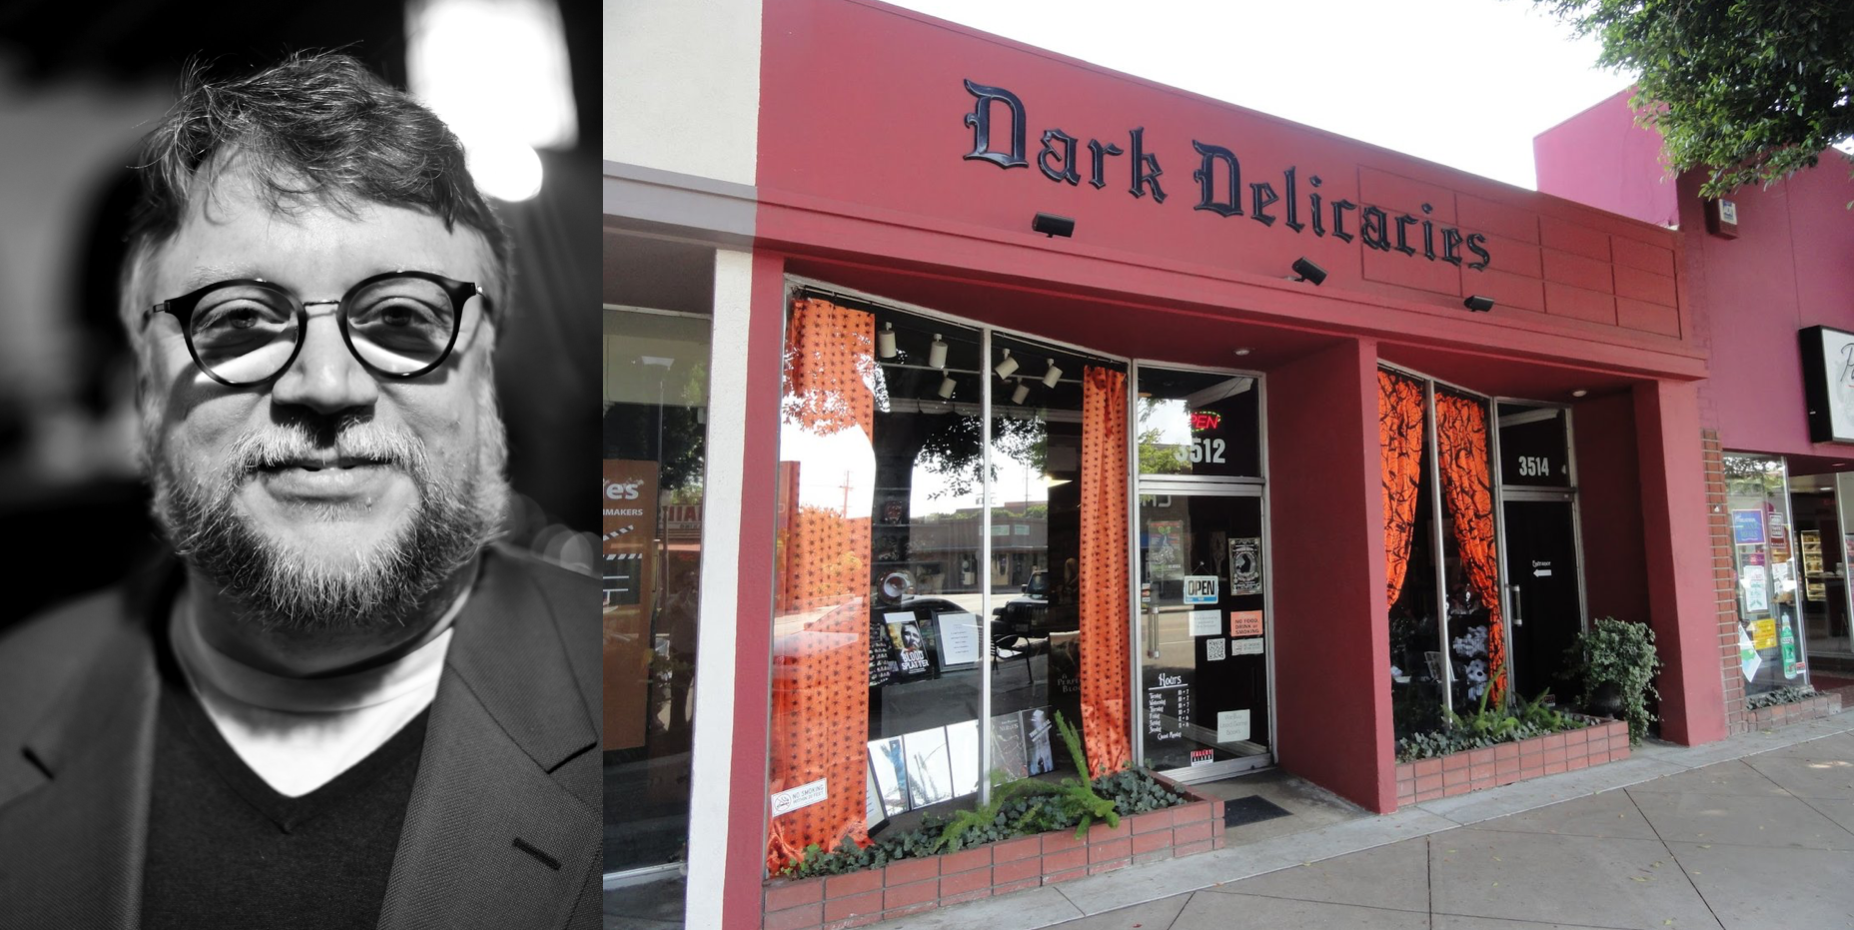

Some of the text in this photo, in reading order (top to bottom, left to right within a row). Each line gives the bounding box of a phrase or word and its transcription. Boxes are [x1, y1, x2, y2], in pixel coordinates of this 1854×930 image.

[963, 79, 1491, 272] Dark Delicacies
[1191, 413, 1218, 430] PEN
[1173, 437, 1226, 464] 3512
[1518, 455, 1549, 477] 3514
[603, 482, 639, 500] es
[1188, 580, 1215, 596] OPEN
[901, 649, 924, 662] BLOOD
[1158, 672, 1182, 687] Hours
